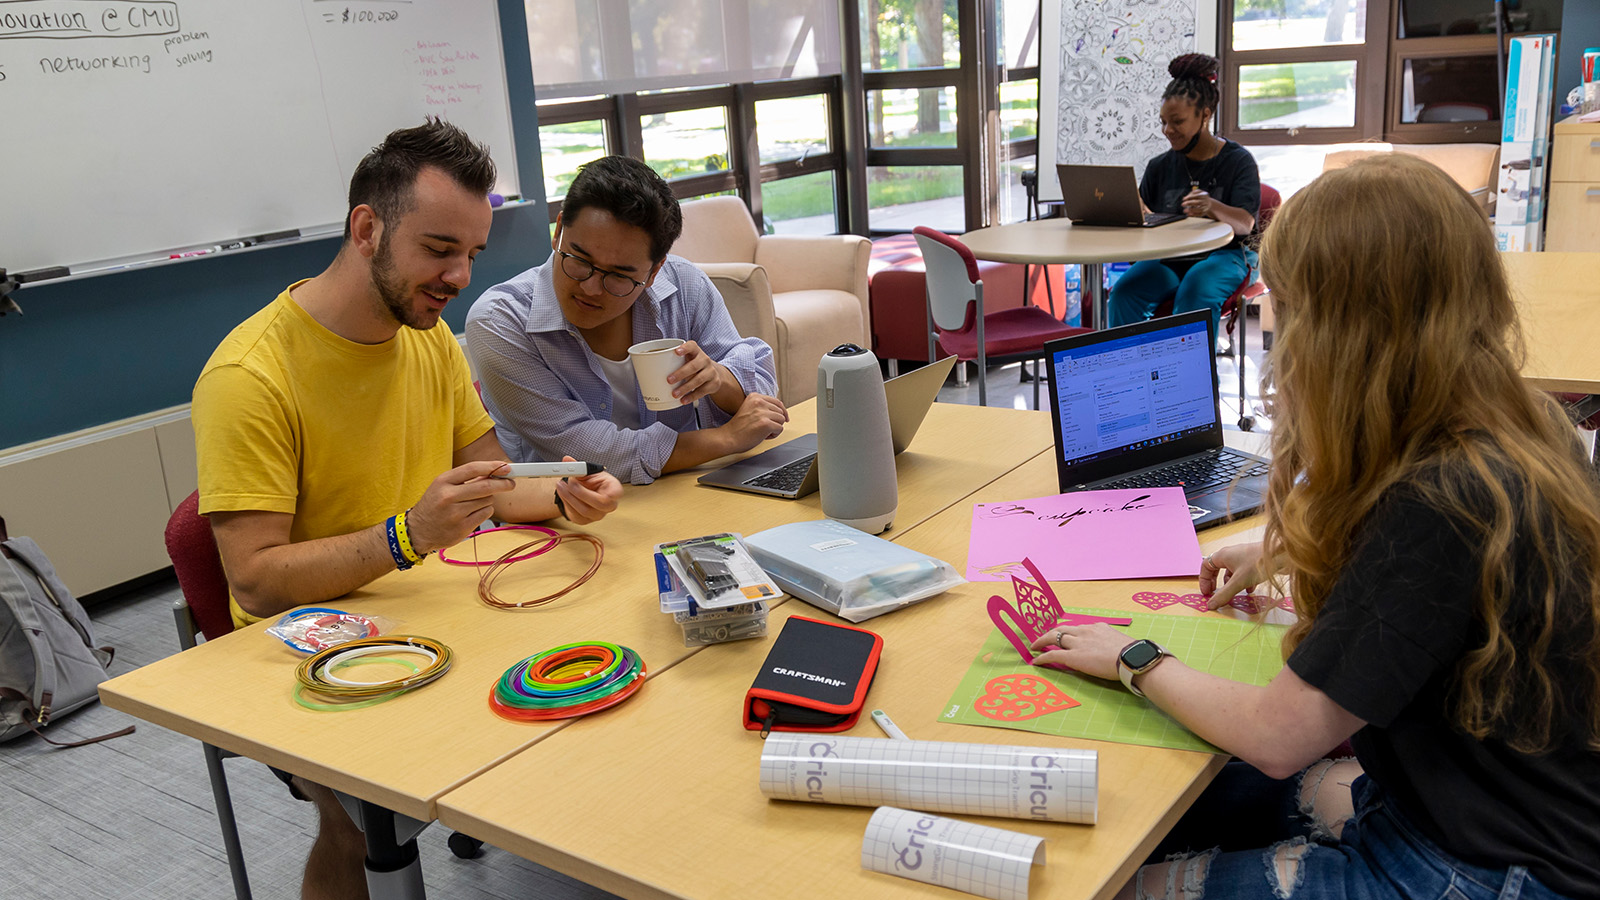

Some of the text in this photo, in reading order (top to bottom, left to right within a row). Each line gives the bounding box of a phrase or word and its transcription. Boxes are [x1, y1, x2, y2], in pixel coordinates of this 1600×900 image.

[0, 6, 175, 31] ovation @ CMU
[164, 31, 210, 53] problem
[39, 54, 151, 74] networking
[176, 49, 213, 67] solving
[772, 667, 842, 687] CRAFTSMAN
[806, 741, 835, 802] Cricu
